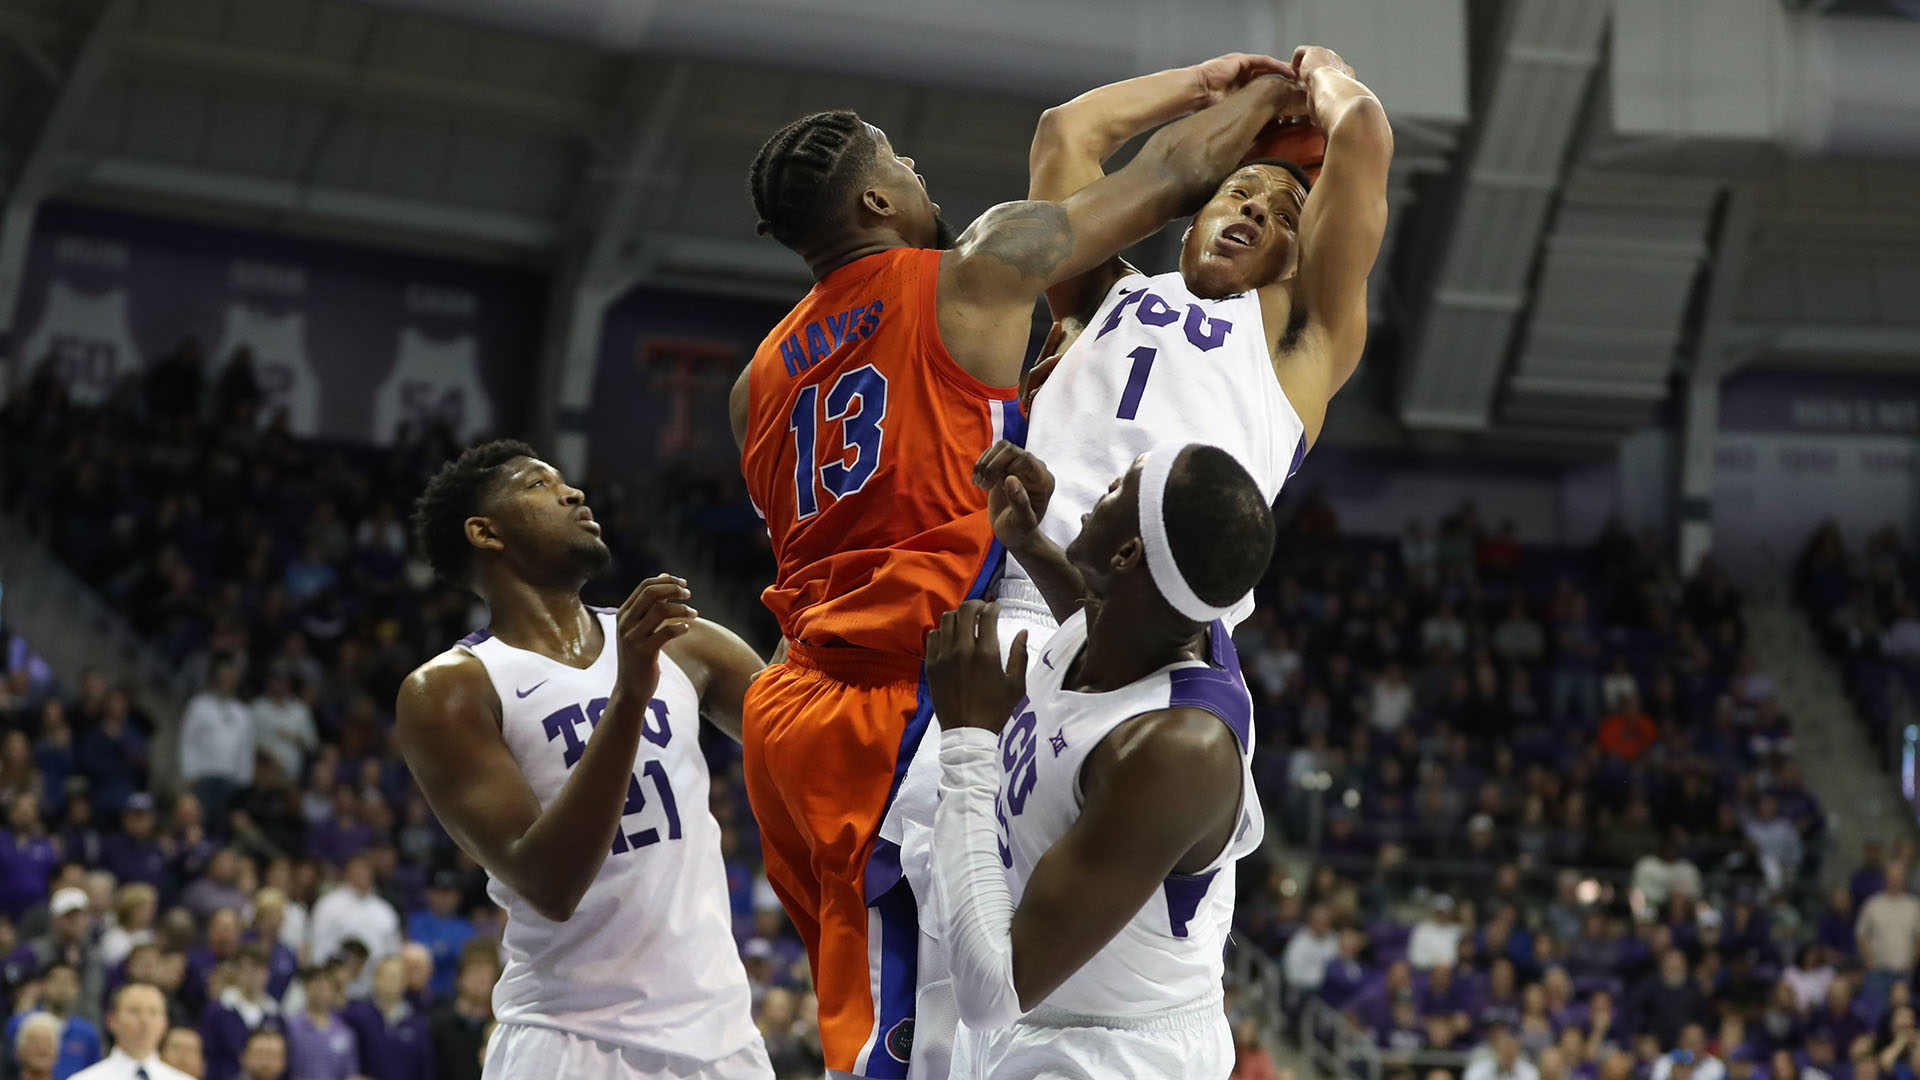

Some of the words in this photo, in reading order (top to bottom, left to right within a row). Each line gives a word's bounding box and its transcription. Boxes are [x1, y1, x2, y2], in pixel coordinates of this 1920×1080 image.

[779, 299, 884, 378] HAYES
[1094, 287, 1233, 351] TCU
[1116, 346, 1157, 420] 1
[790, 363, 888, 521] 13
